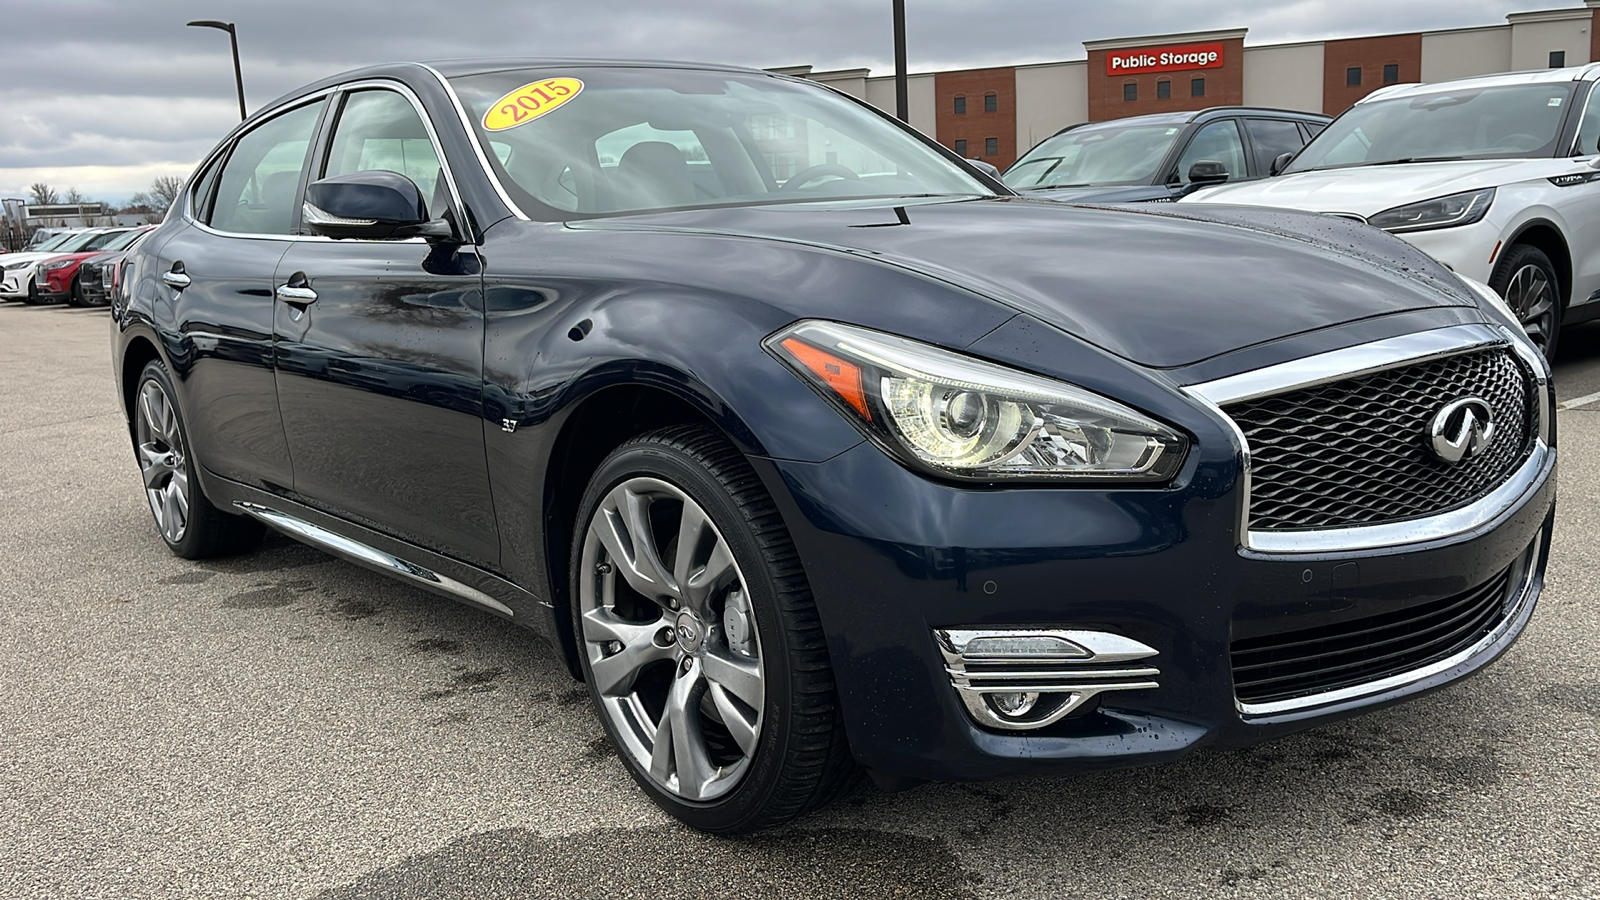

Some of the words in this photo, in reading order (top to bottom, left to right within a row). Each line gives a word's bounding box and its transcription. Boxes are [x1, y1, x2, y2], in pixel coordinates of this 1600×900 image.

[1112, 54, 1156, 69] Public
[1159, 51, 1218, 66] Storage
[500, 81, 571, 122] 2015
